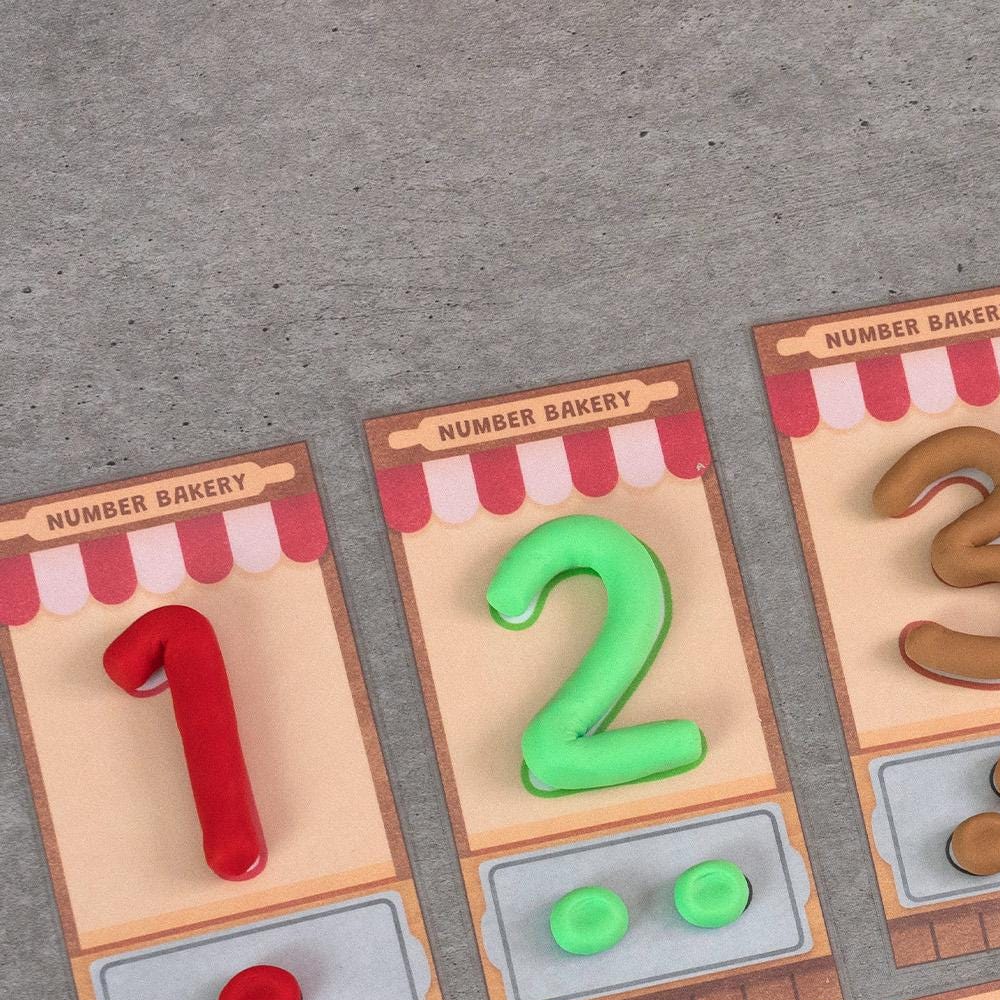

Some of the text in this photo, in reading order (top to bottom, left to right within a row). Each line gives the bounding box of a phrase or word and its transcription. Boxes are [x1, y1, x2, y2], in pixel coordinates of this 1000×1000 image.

[824, 318, 921, 350] NUMBER
[437, 389, 631, 442] NUMBER BAKERY
[45, 472, 246, 531] NUMBER BAKERY
[486, 515, 705, 798] 2
[103, 604, 268, 881] 1
